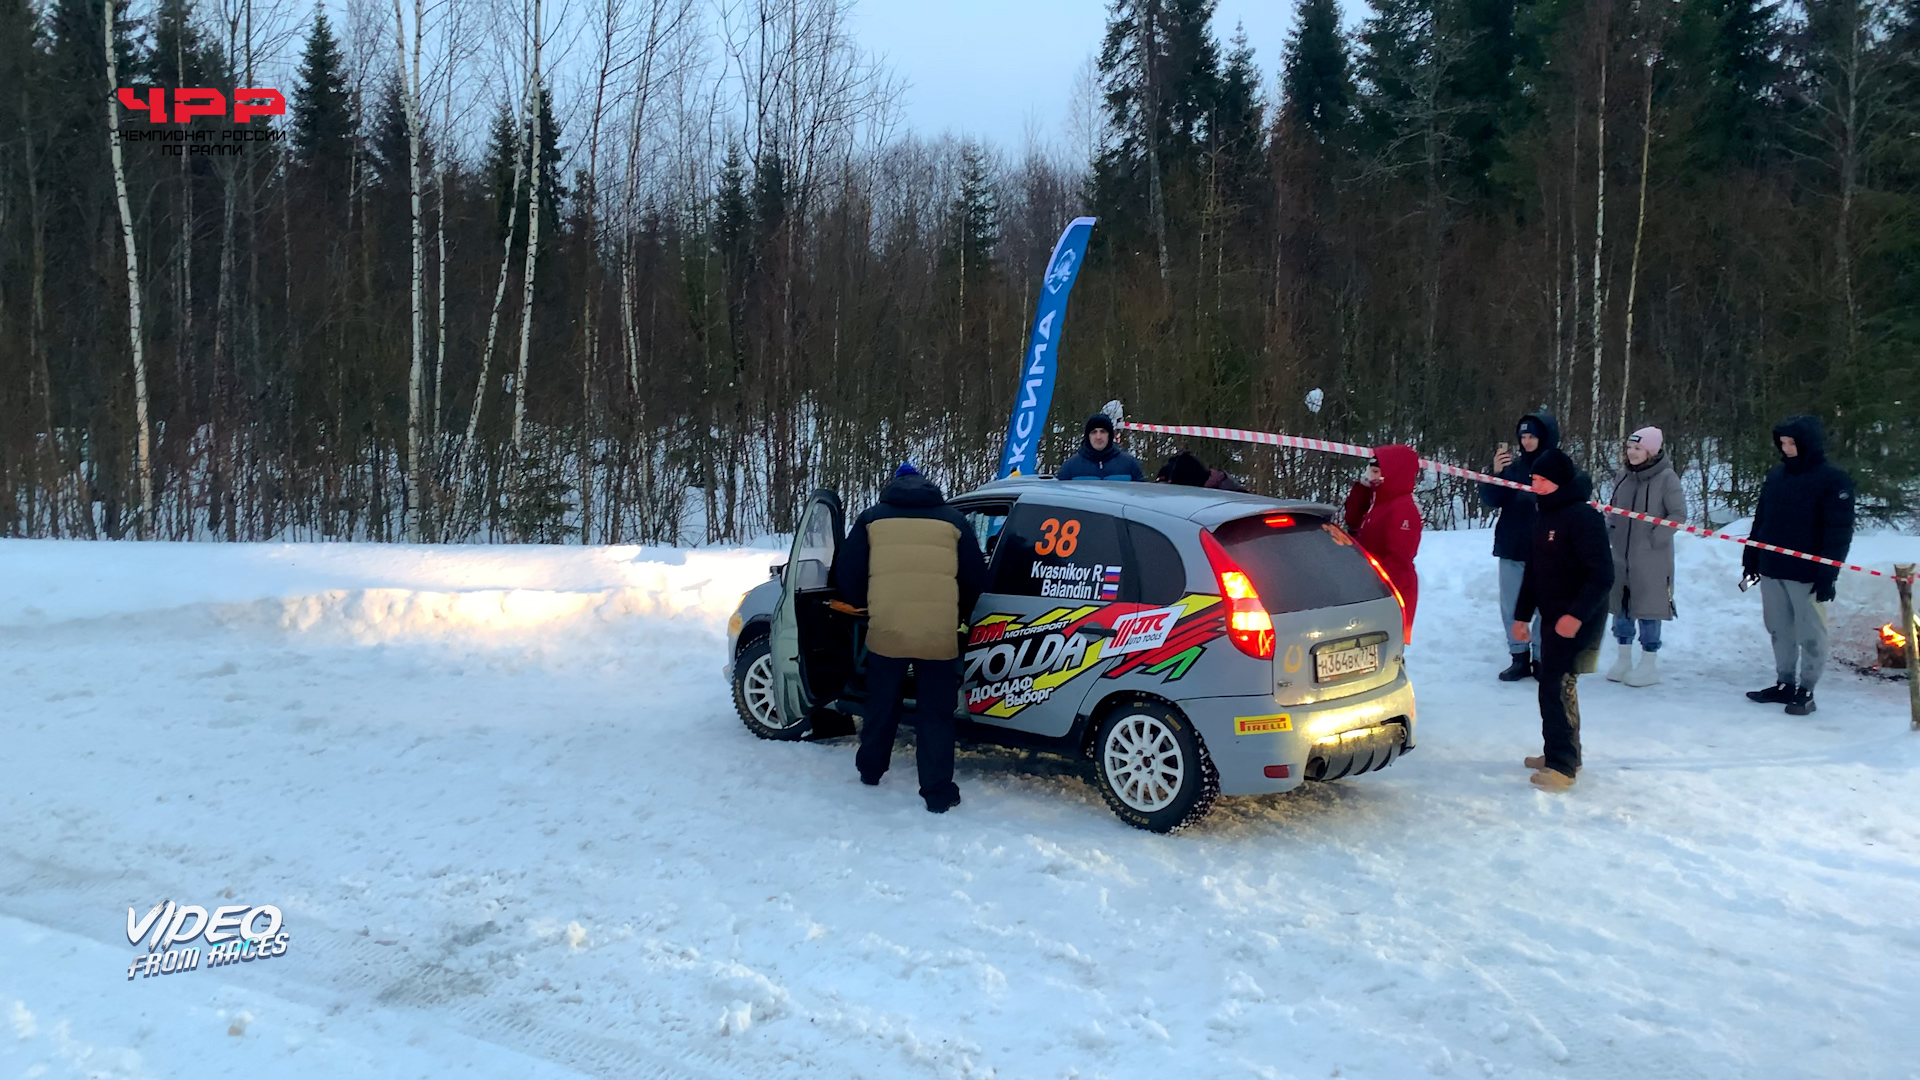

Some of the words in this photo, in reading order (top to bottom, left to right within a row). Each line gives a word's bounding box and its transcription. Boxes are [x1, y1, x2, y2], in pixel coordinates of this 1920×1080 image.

[1008, 310, 1057, 473] КСИМА
[1035, 518, 1080, 558] 38
[1030, 561, 1091, 581] Kvasnikov
[1091, 564, 1104, 582] R.
[1041, 579, 1092, 599] Balandin
[968, 621, 1008, 646] DM
[1004, 620, 1070, 639] MOTORSPORT
[1142, 632, 1163, 643] TOOLS
[969, 676, 1033, 705] ДОСААФ
[1005, 687, 1054, 708] Выборг
[1240, 717, 1287, 732] PIRELLI
